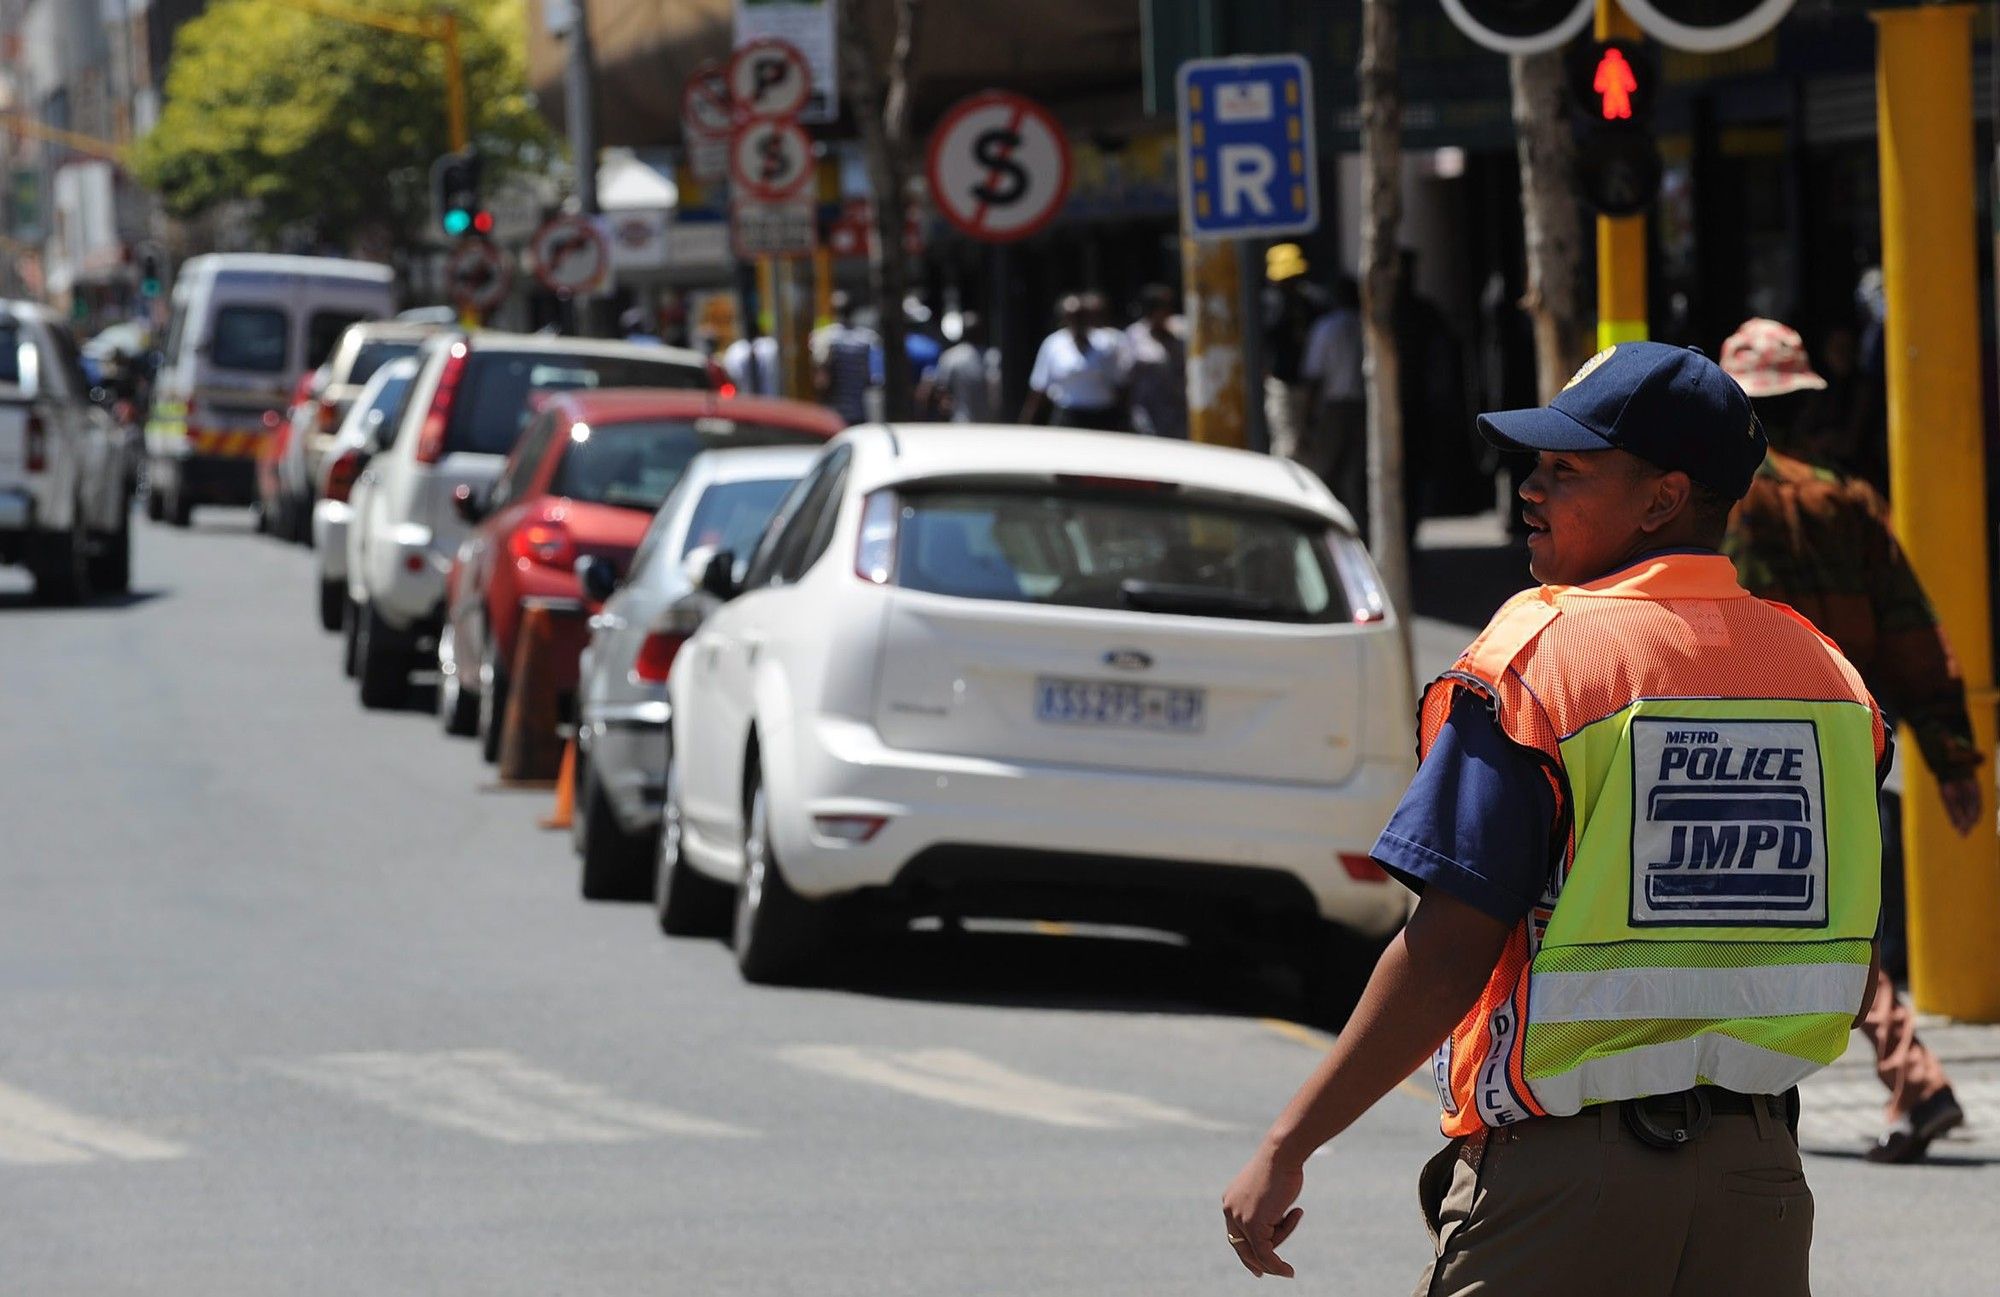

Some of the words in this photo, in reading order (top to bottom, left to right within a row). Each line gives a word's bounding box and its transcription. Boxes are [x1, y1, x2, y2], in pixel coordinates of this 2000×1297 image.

[754, 58, 787, 100] P
[756, 135, 791, 182] S
[971, 127, 1029, 206] S
[1220, 144, 1276, 216] R
[1665, 731, 1718, 744] METRO
[1659, 747, 1803, 781] POLICE
[1648, 825, 1812, 870] JMPD
